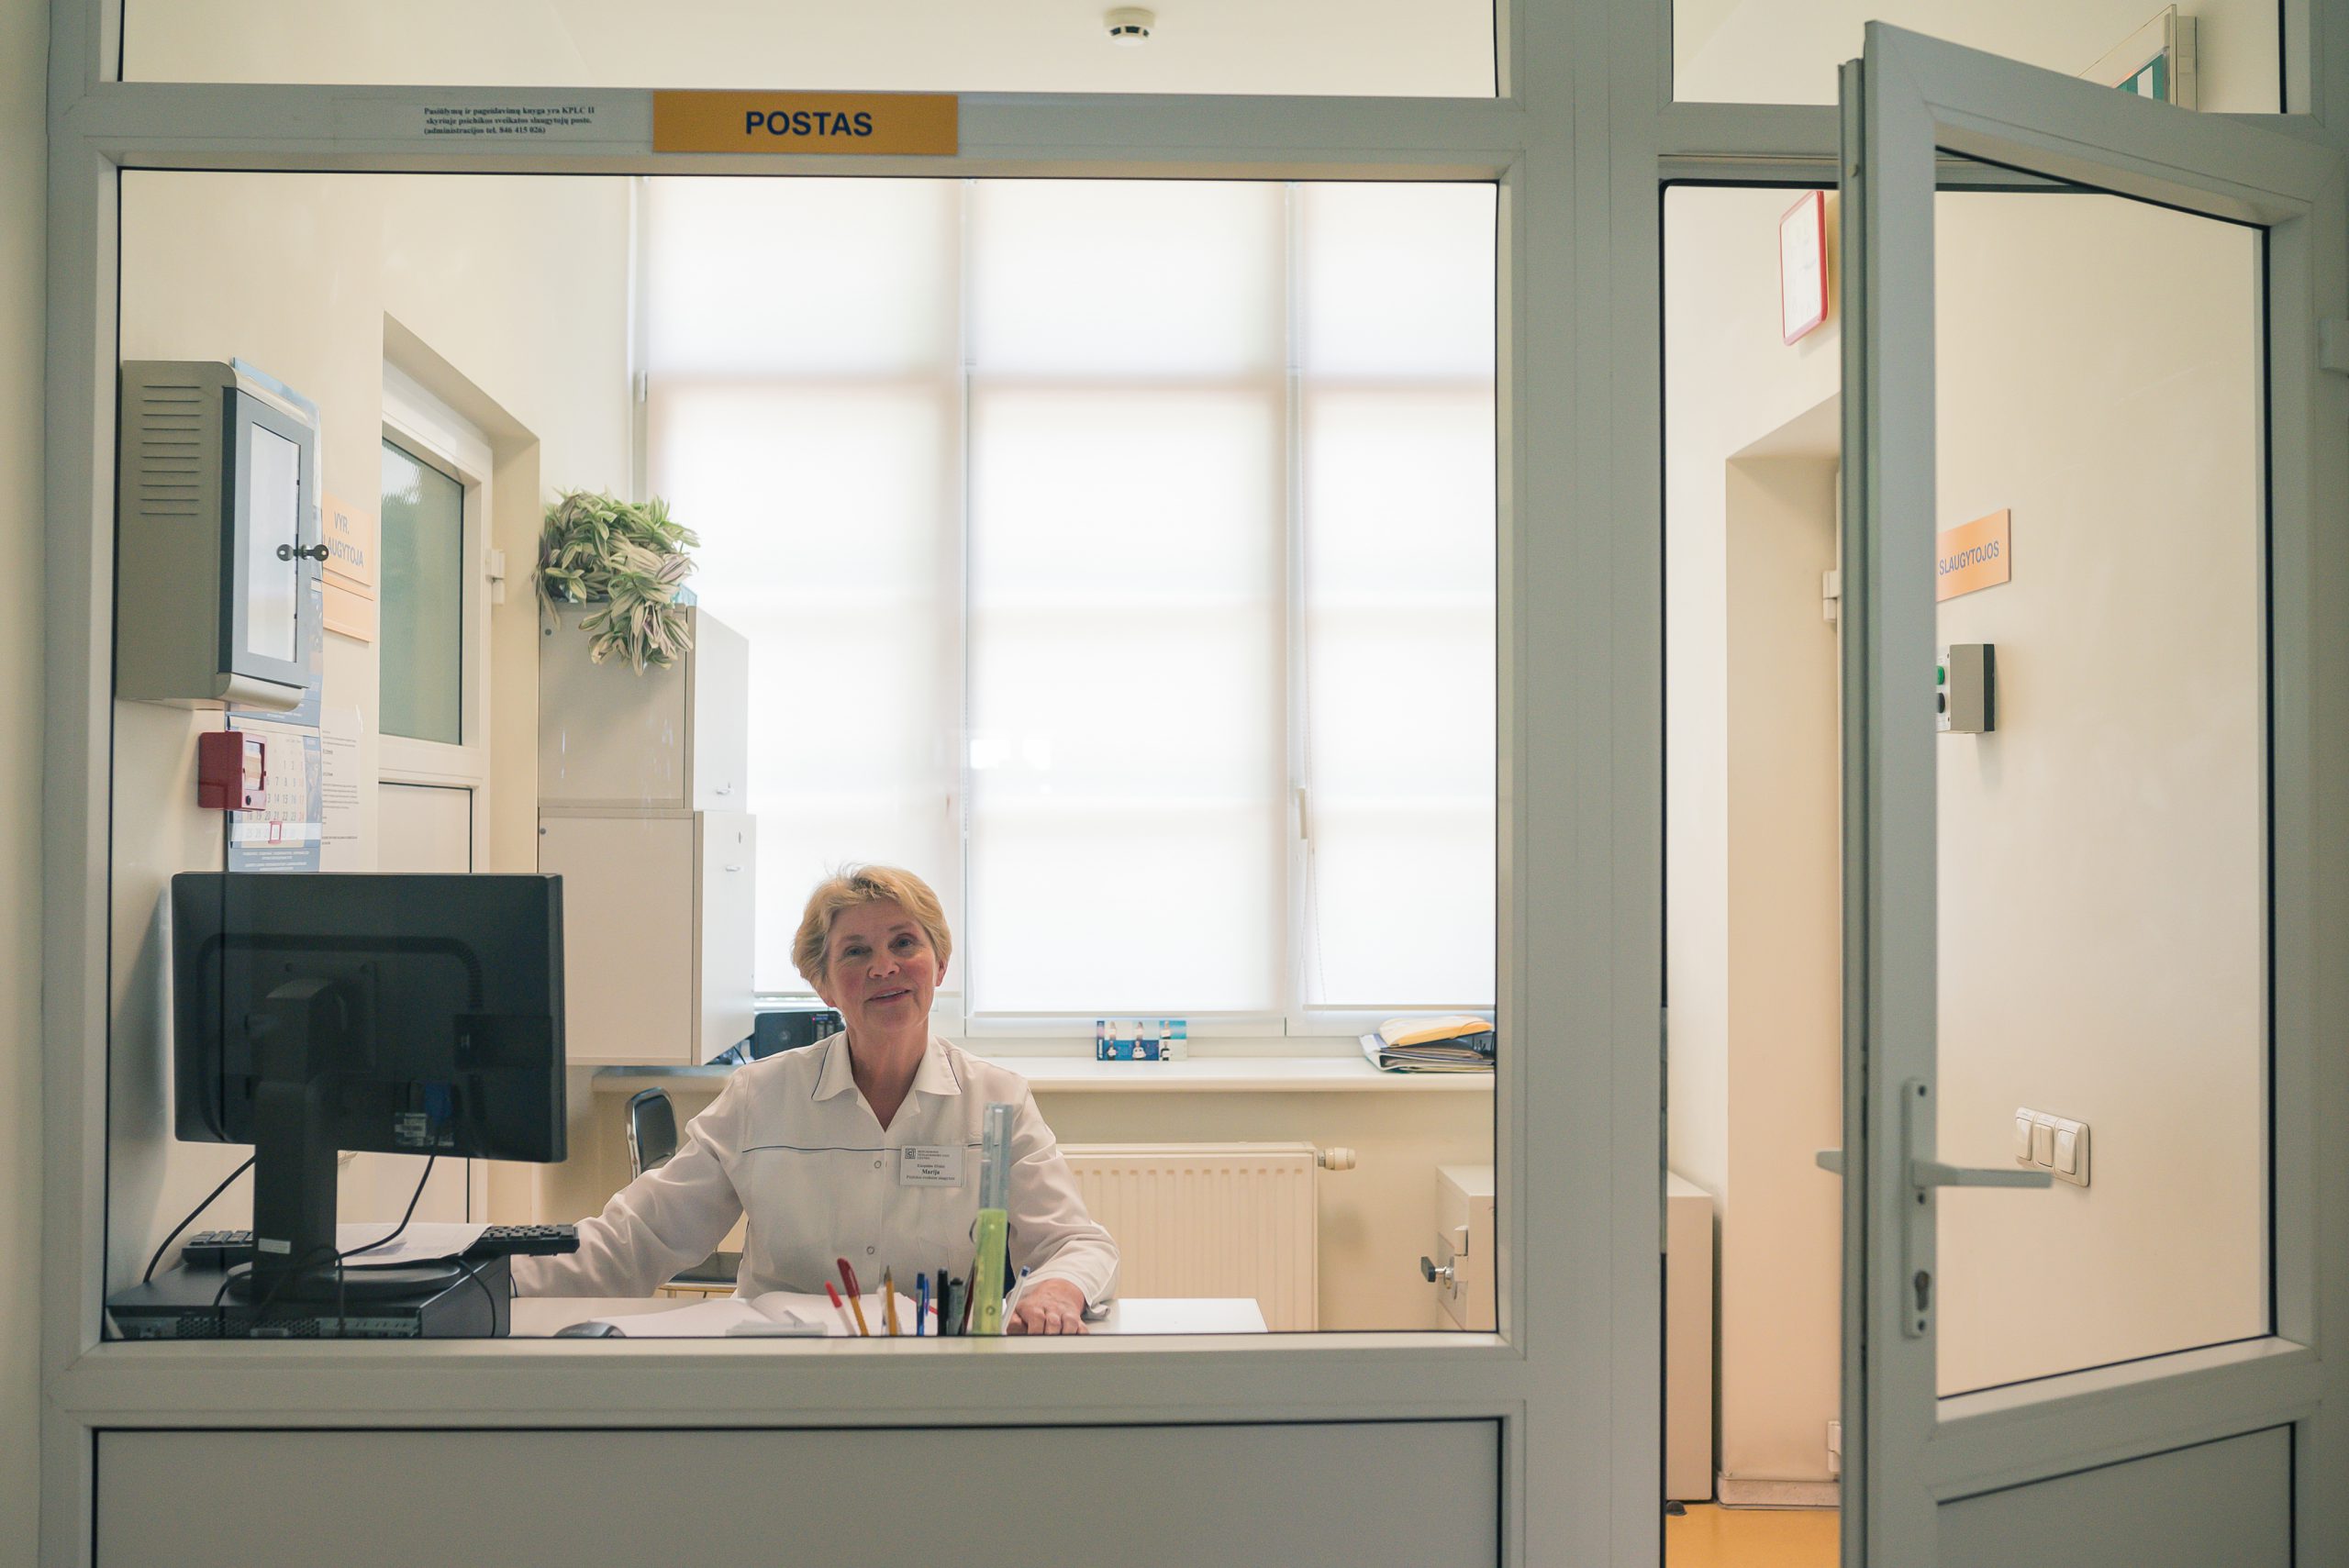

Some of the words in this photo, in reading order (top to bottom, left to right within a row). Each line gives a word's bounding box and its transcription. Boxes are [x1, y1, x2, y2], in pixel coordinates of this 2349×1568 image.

[473, 107, 520, 116] pageidavimų
[523, 106, 545, 116] knyga
[459, 117, 493, 126] psichikos
[530, 117, 569, 125] slaugytojų
[745, 110, 874, 137] POSTAS
[424, 127, 484, 135] (administracijos
[333, 511, 350, 535] VYR.
[1939, 539, 1999, 576] SLAUGYTOJOS
[921, 1168, 941, 1176] Marija
